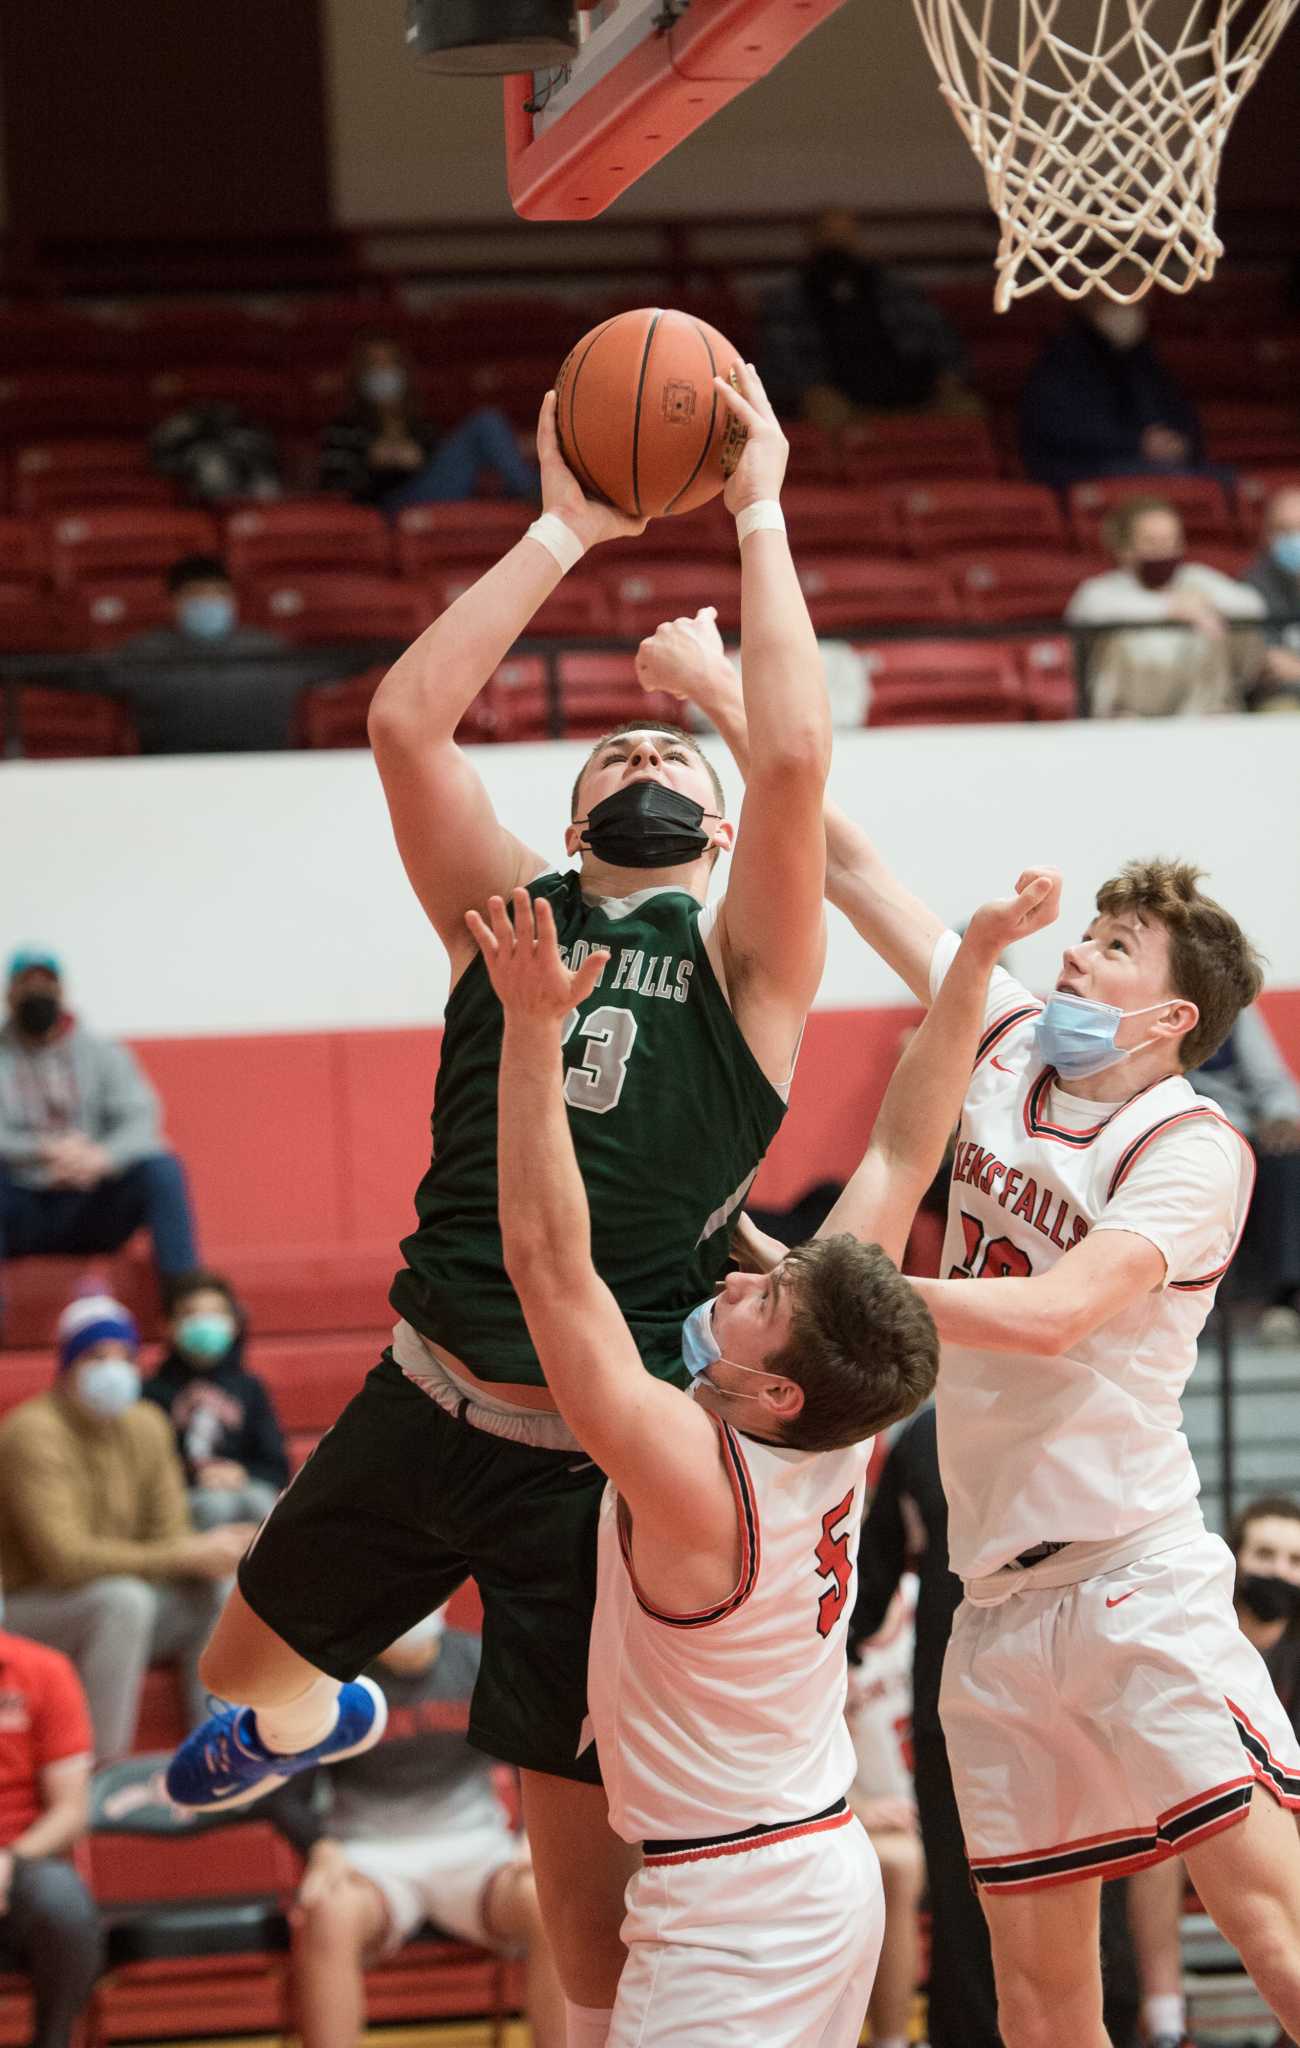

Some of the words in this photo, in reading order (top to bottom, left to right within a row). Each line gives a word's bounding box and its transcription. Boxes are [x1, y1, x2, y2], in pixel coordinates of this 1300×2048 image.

[610, 948, 694, 1003] FALLS
[561, 1006, 637, 1114] 3
[998, 1166, 1088, 1252] FALLS
[815, 1486, 854, 1639] 5
